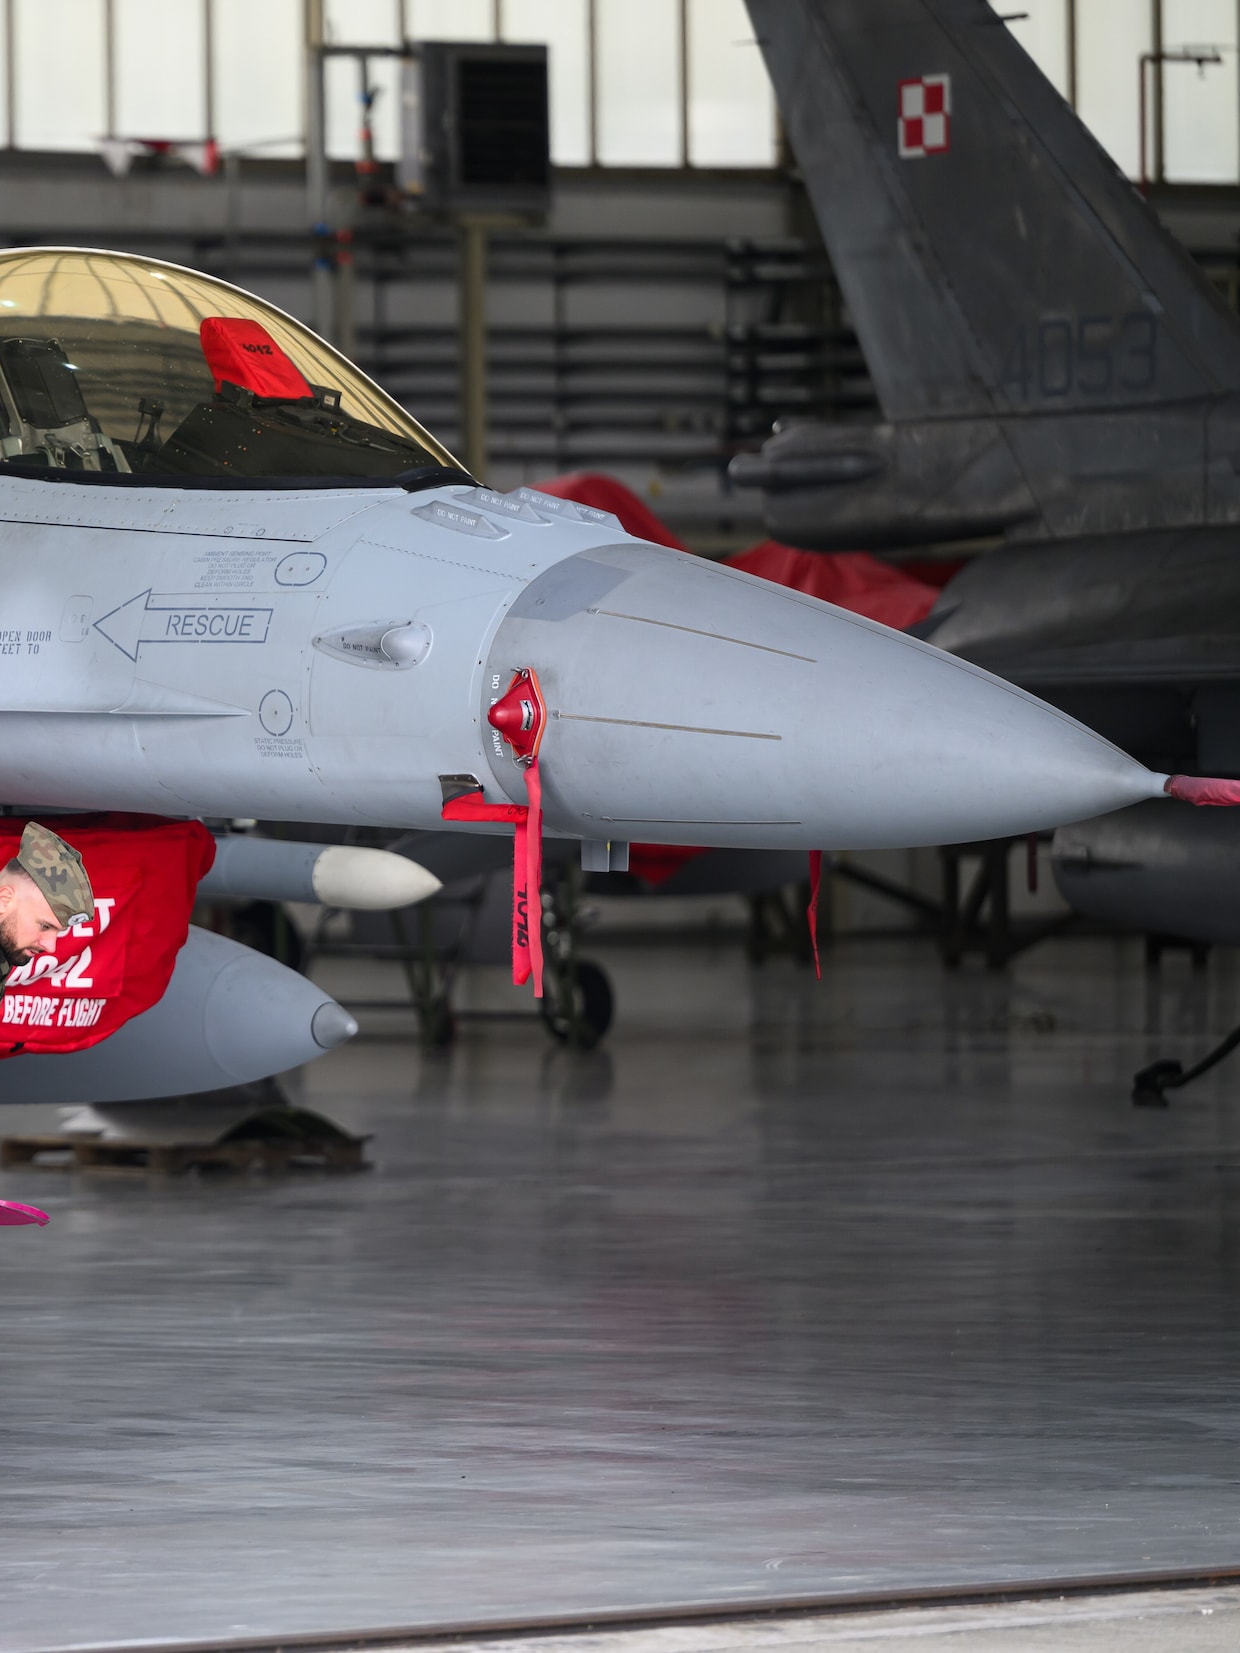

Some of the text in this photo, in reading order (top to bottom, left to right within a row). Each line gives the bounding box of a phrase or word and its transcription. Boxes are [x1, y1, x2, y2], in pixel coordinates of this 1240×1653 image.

[242, 344, 273, 355] 4042
[1000, 311, 1157, 400] 4053
[480, 493, 520, 512] DO NOT PAINT
[530, 496, 543, 504] NOT
[544, 500, 560, 510] PAINT
[437, 509, 477, 527] DO NOT PAINT
[589, 511, 605, 520] PAINT
[165, 614, 254, 636] RESCUE
[27, 630, 52, 642] DOOR
[28, 643, 40, 655] TO
[365, 645, 381, 653] PAINT
[491, 674, 500, 689] DO
[491, 729, 504, 757] PAINT
[2, 995, 59, 1026] BEFORE
[57, 998, 106, 1028] FLIGHT
